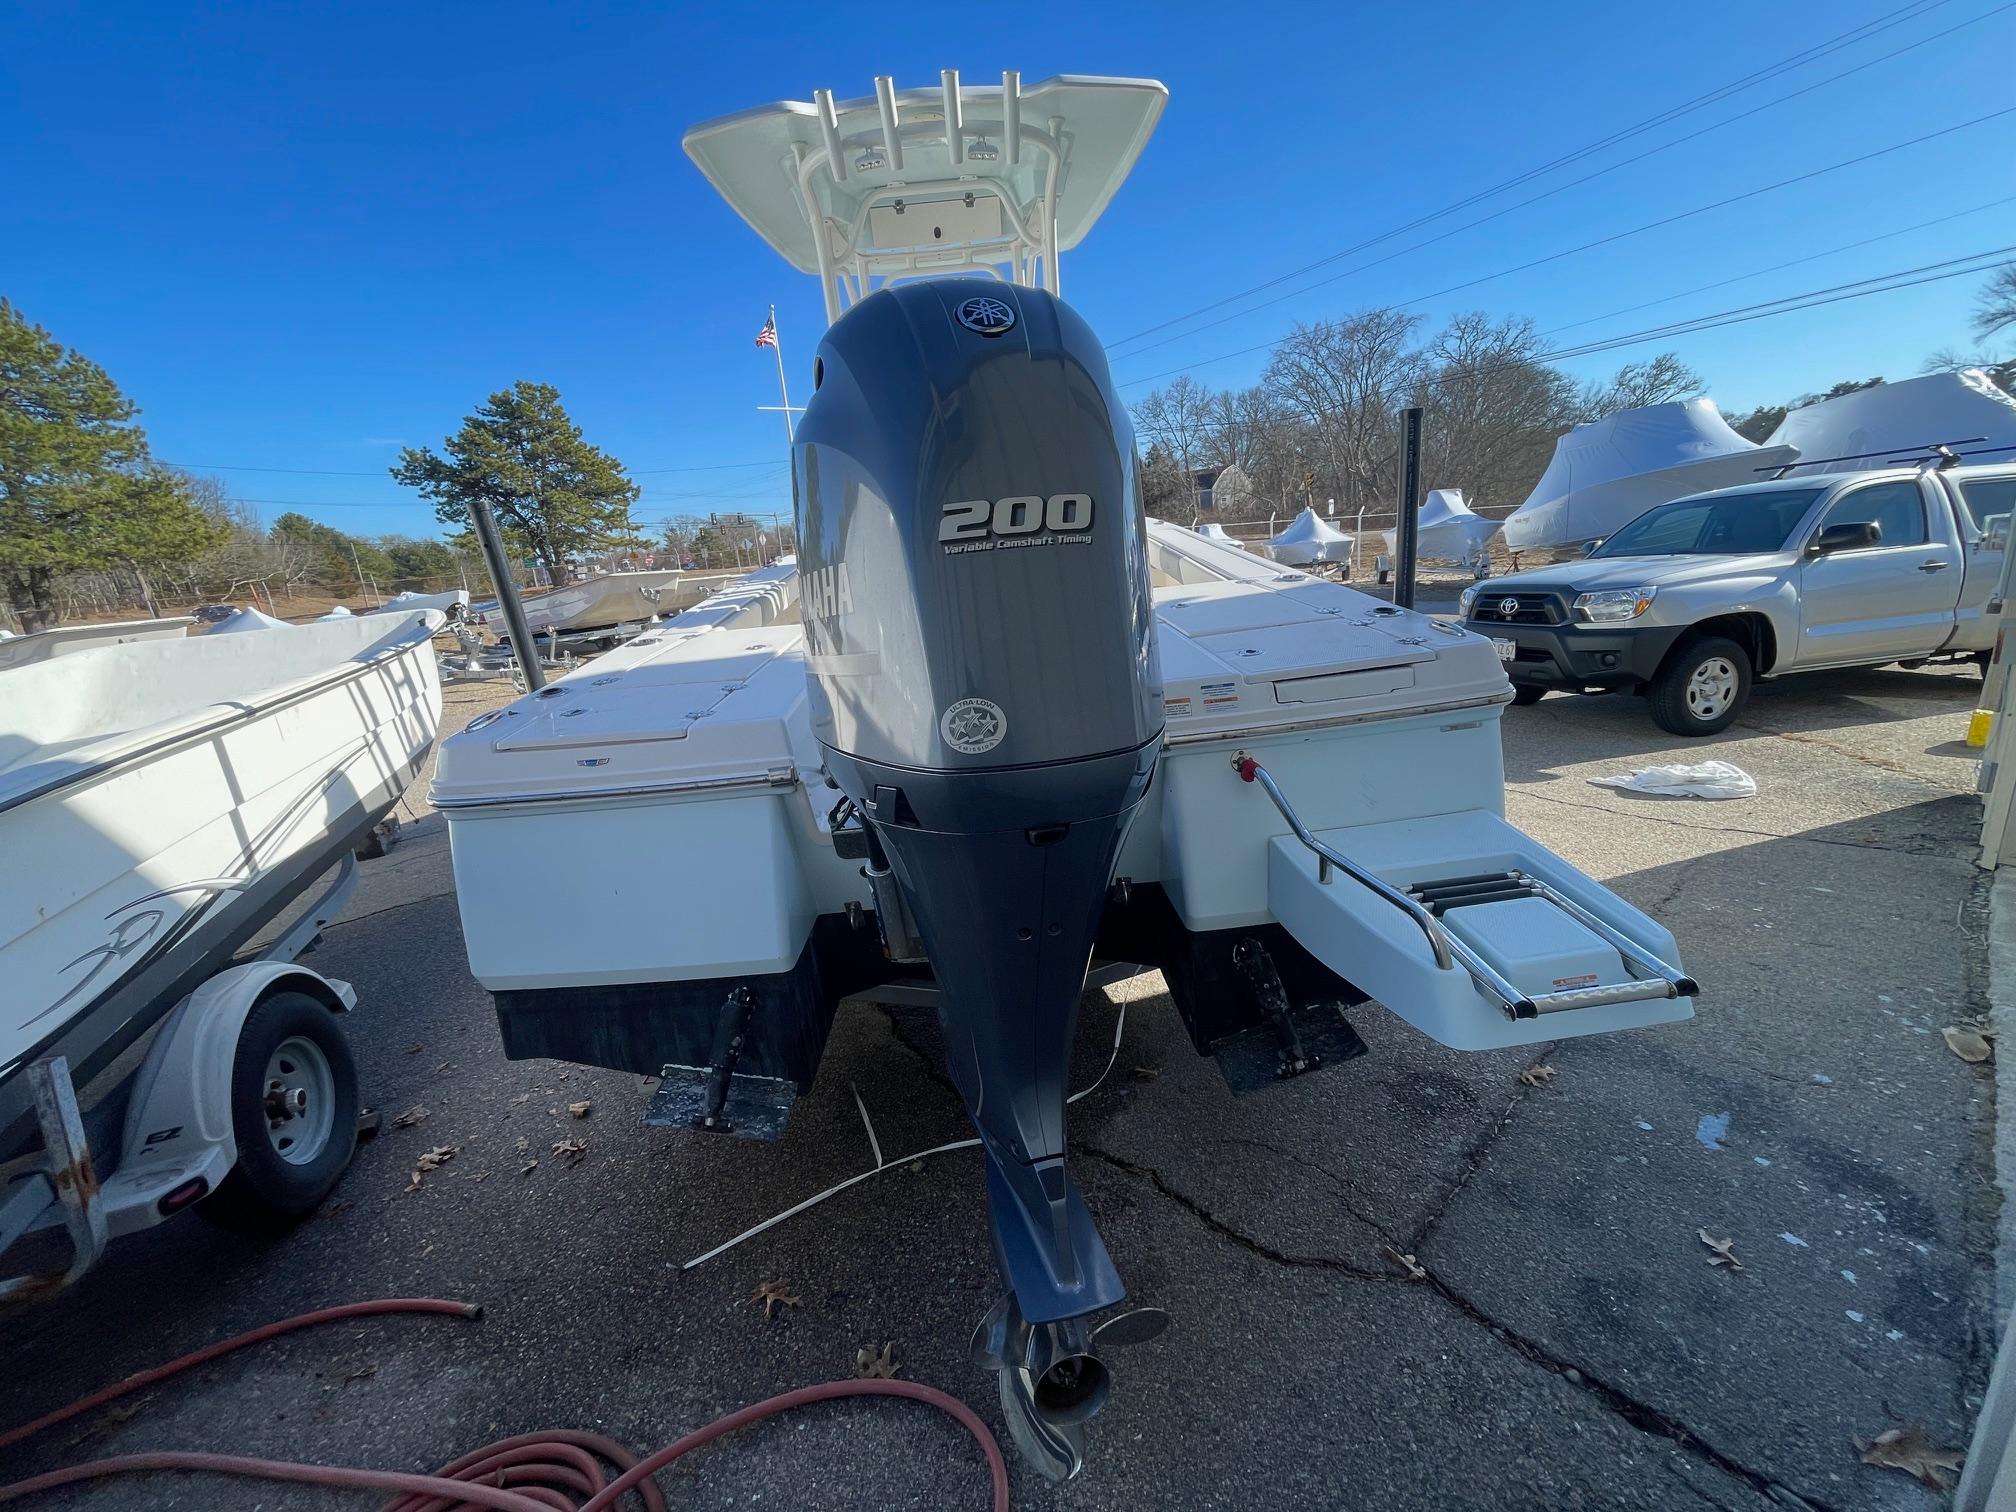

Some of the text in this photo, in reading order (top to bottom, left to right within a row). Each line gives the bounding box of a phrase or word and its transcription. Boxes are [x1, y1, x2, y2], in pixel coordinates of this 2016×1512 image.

[938, 493, 1092, 542] 200
[944, 534, 1092, 554] Variable Camshaft Timing
[801, 563, 855, 619] MAHA
[144, 1126, 185, 1146] EZ
